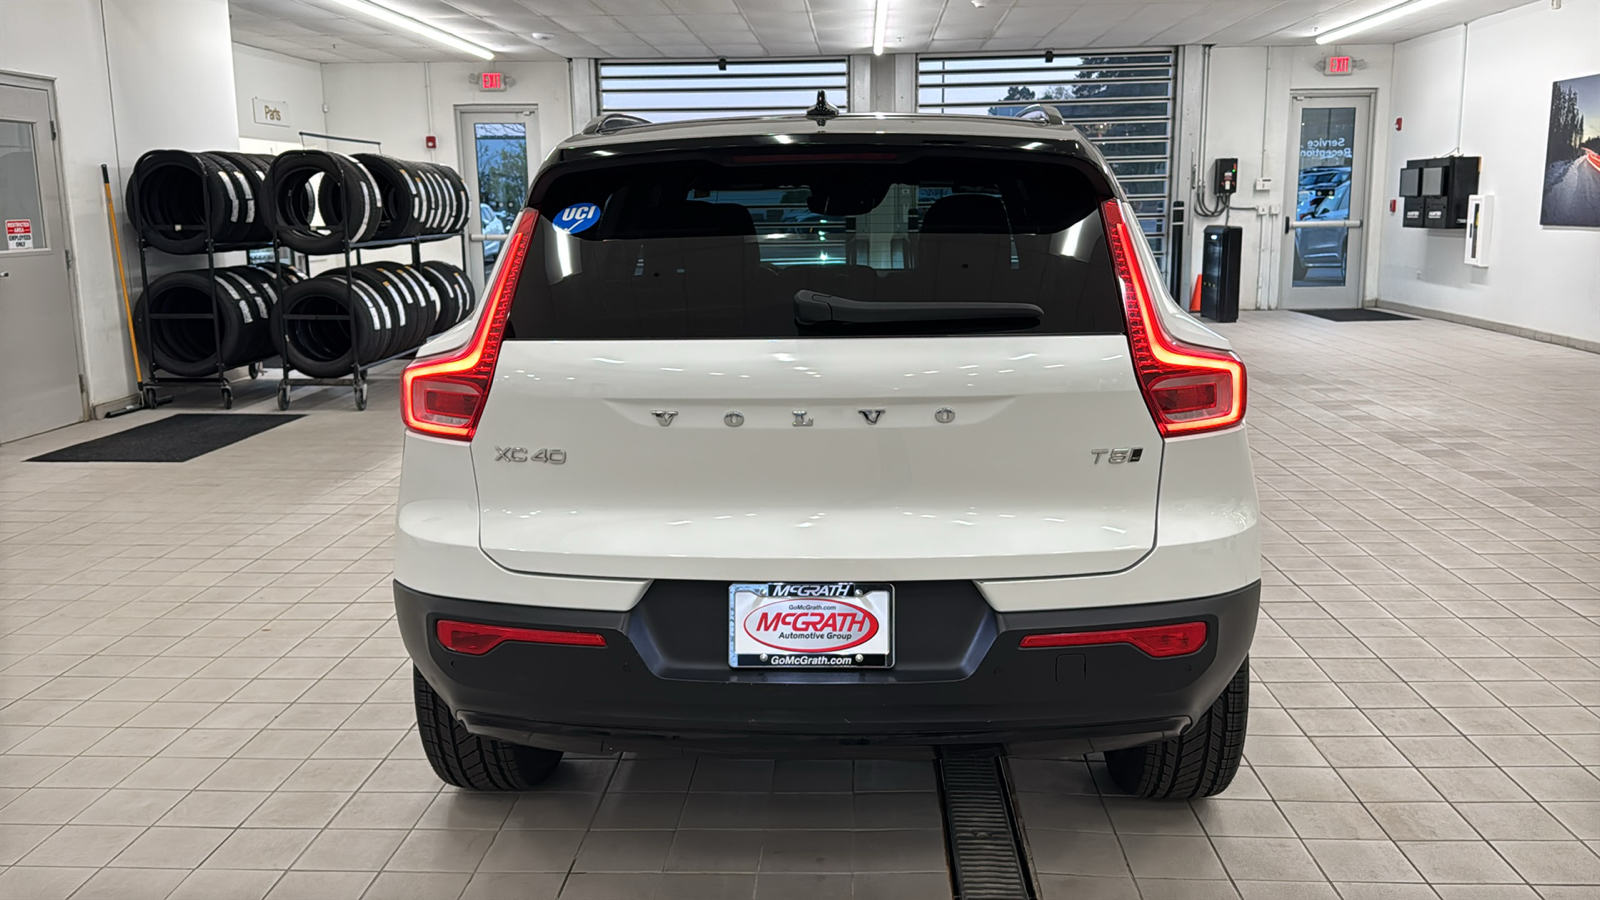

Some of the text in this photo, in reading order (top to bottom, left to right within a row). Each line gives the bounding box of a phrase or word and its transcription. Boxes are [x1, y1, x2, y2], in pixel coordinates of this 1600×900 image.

[1330, 56, 1349, 72] EXIT
[482, 72, 501, 88] EXIT
[264, 105, 281, 121] Parts
[562, 205, 597, 221] UCI
[651, 406, 956, 428] VOLVO
[778, 632, 852, 641] Automotive Group
[770, 655, 852, 665] GoMcGrath.com
